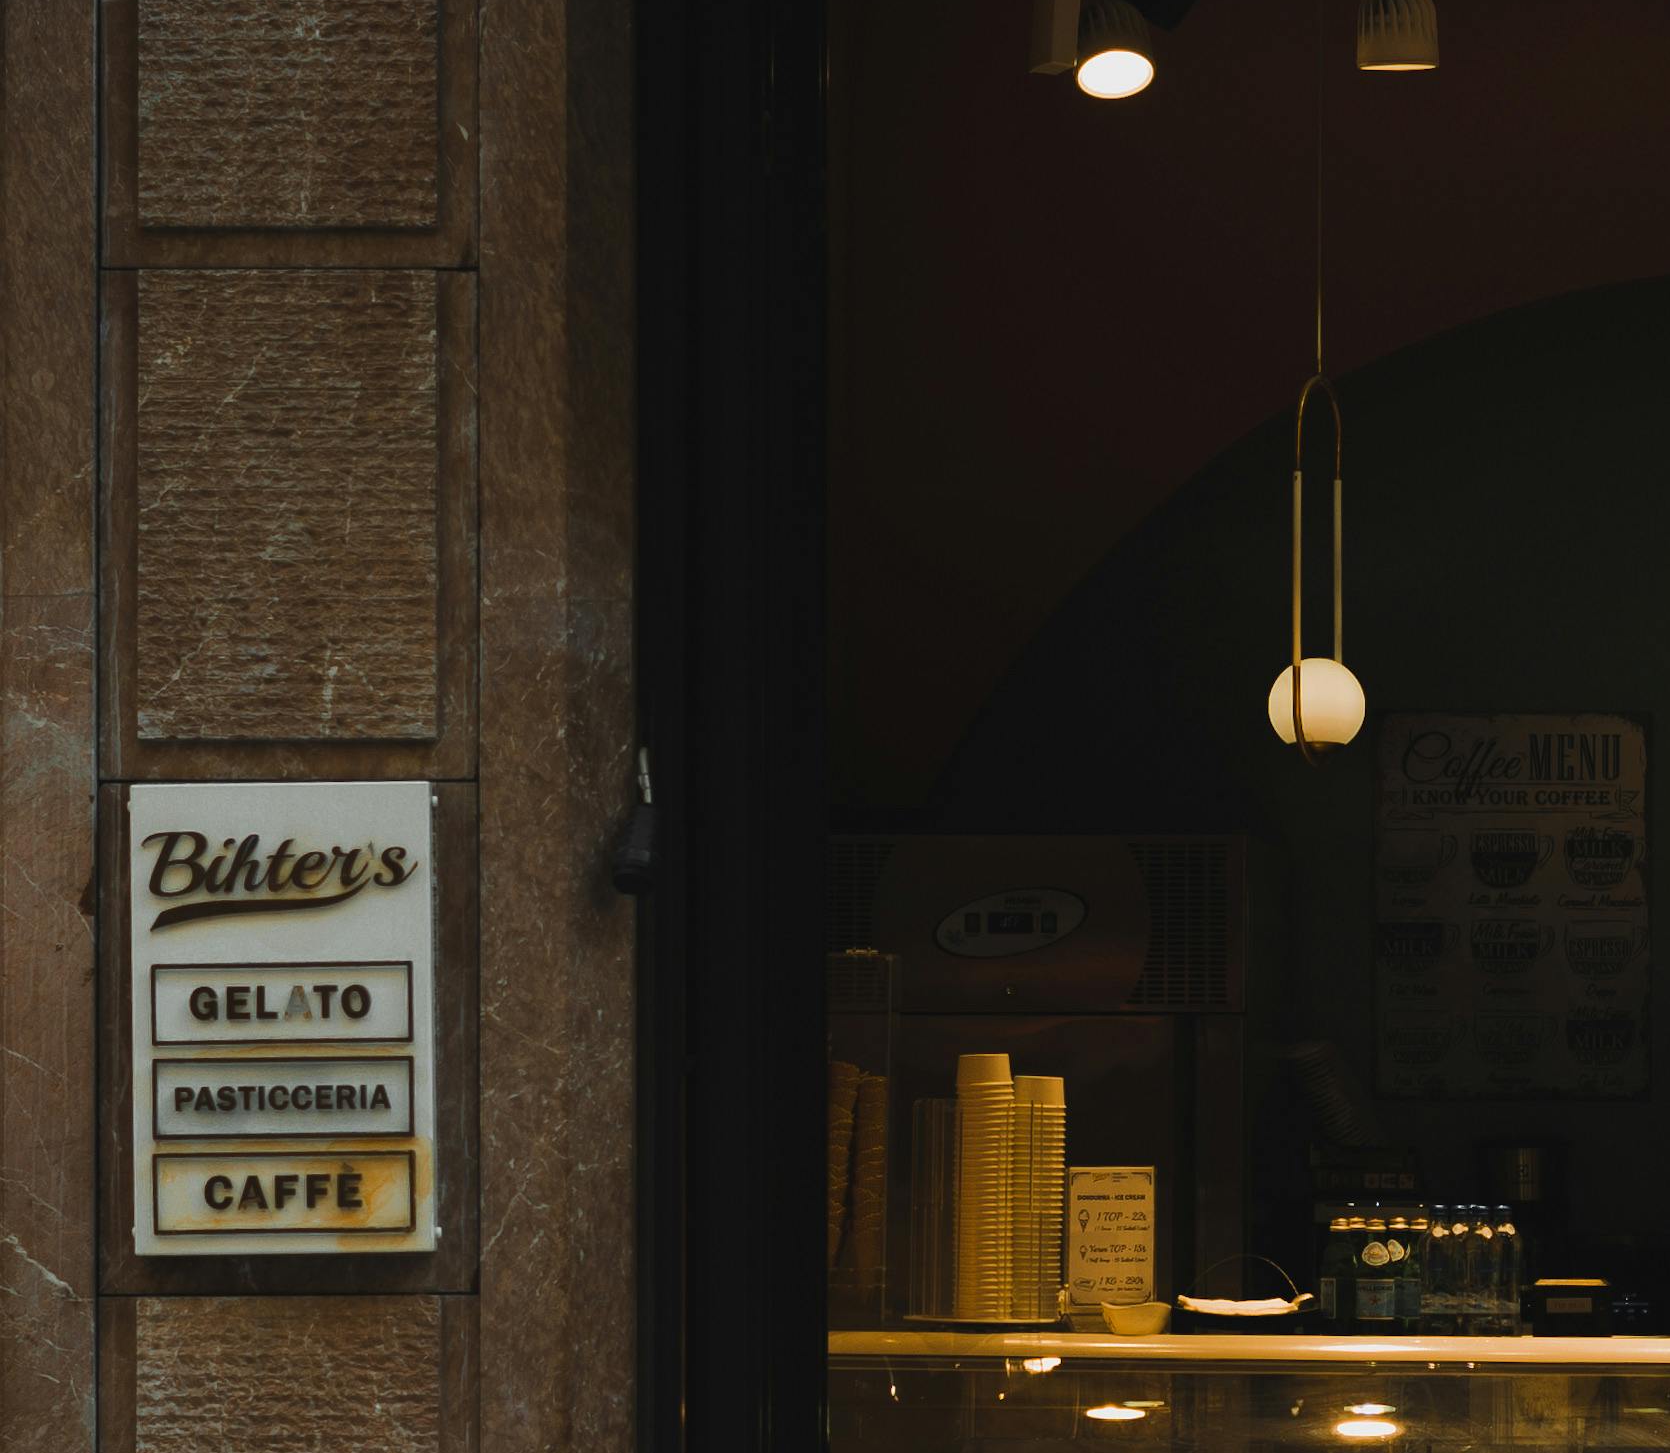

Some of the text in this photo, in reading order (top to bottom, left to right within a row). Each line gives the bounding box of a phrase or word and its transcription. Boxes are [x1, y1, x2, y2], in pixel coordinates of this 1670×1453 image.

[1528, 732, 1622, 782] MENU
[1412, 789, 1611, 806] KNOW YOUR COFFEE
[141, 830, 418, 899] Bihter's
[189, 984, 372, 1021] GELATO
[174, 1084, 392, 1113] PASTICCERIA
[203, 1161, 363, 1211] CAFFÈ
